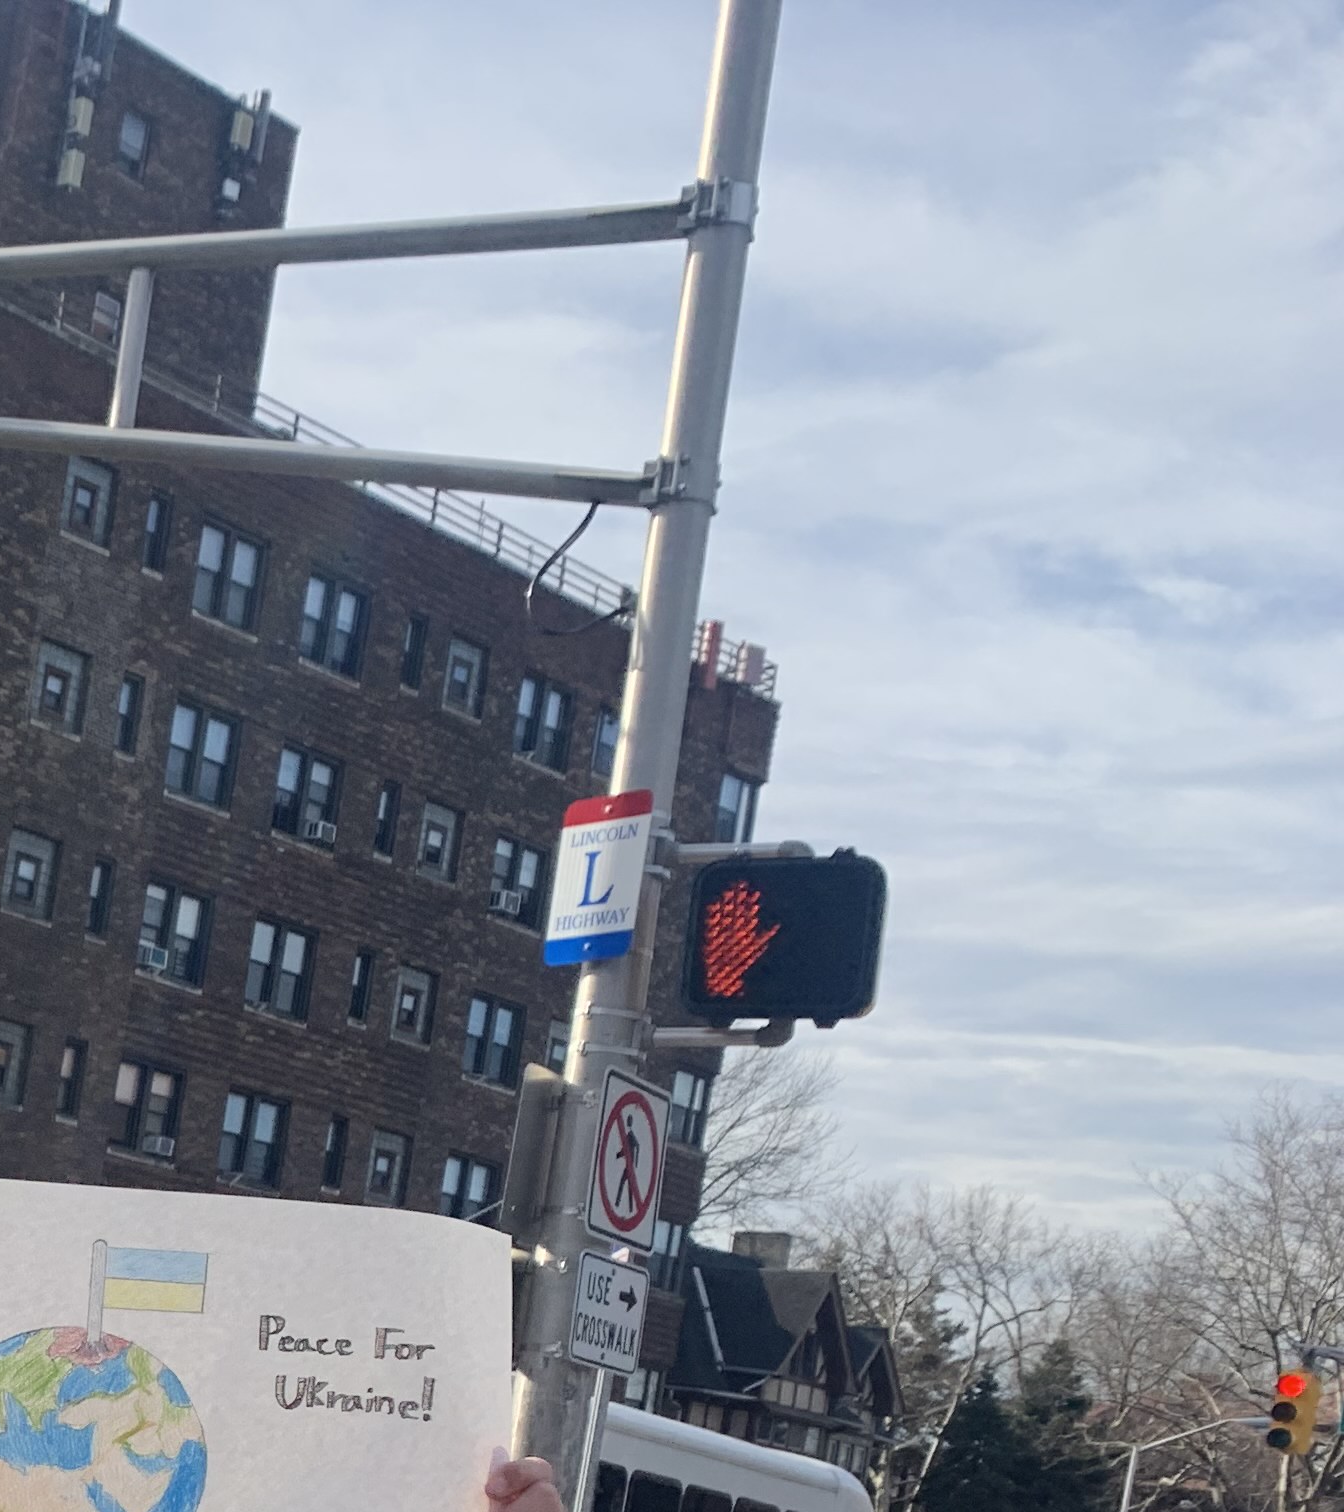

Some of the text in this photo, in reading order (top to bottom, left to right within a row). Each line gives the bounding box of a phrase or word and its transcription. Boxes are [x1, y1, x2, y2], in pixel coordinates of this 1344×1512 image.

[571, 824, 639, 847] LINCOLN
[578, 851, 614, 906] L
[556, 907, 630, 931] HIGHWAY
[587, 1271, 613, 1306] USE
[258, 1314, 436, 1360] Peace For
[575, 1312, 637, 1357] CROSSWALK
